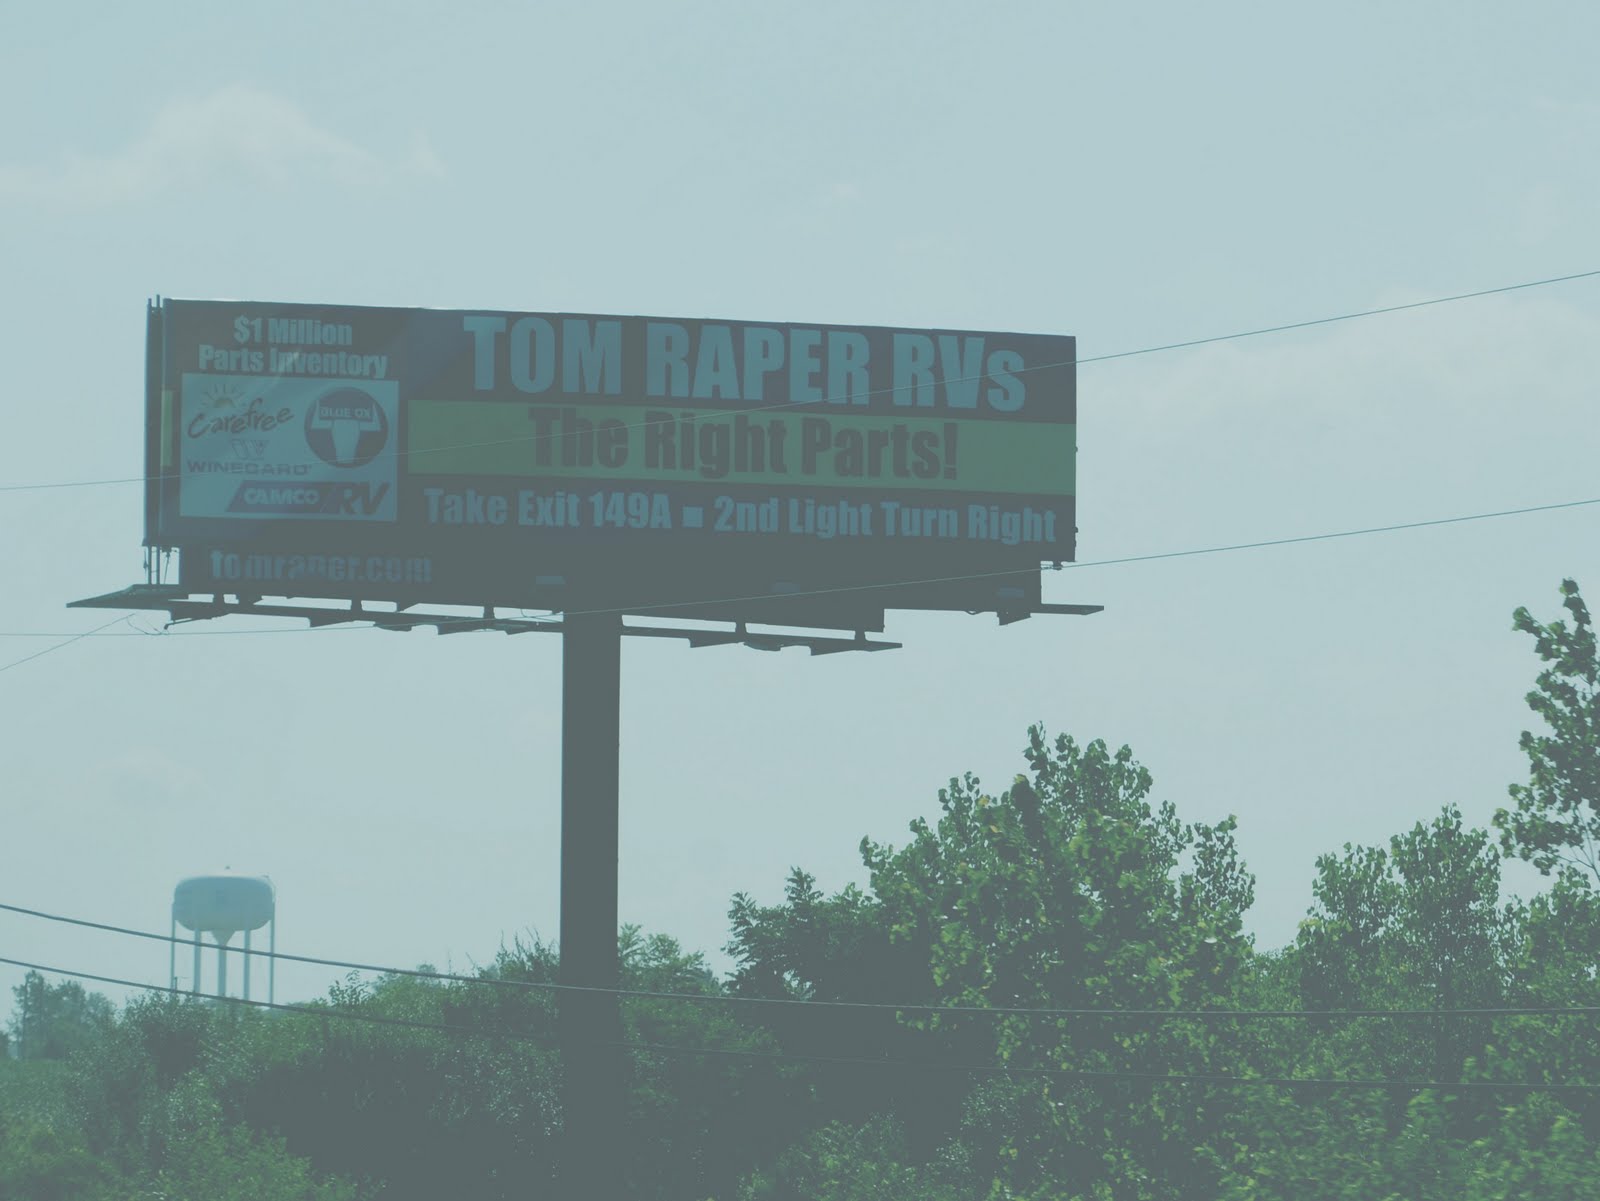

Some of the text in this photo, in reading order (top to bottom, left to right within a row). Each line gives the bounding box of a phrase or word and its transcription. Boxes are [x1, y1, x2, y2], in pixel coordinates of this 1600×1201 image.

[234, 315, 352, 345] $1 Million
[199, 345, 388, 379] Parts Inventory
[463, 315, 1026, 412] TOM RAPER RVs
[187, 398, 294, 439] Carefree
[528, 407, 959, 480] The Right Parts!
[243, 488, 320, 505] CAMCO
[424, 488, 1057, 546] Take Exit 149A 2nd Light Turn Right
